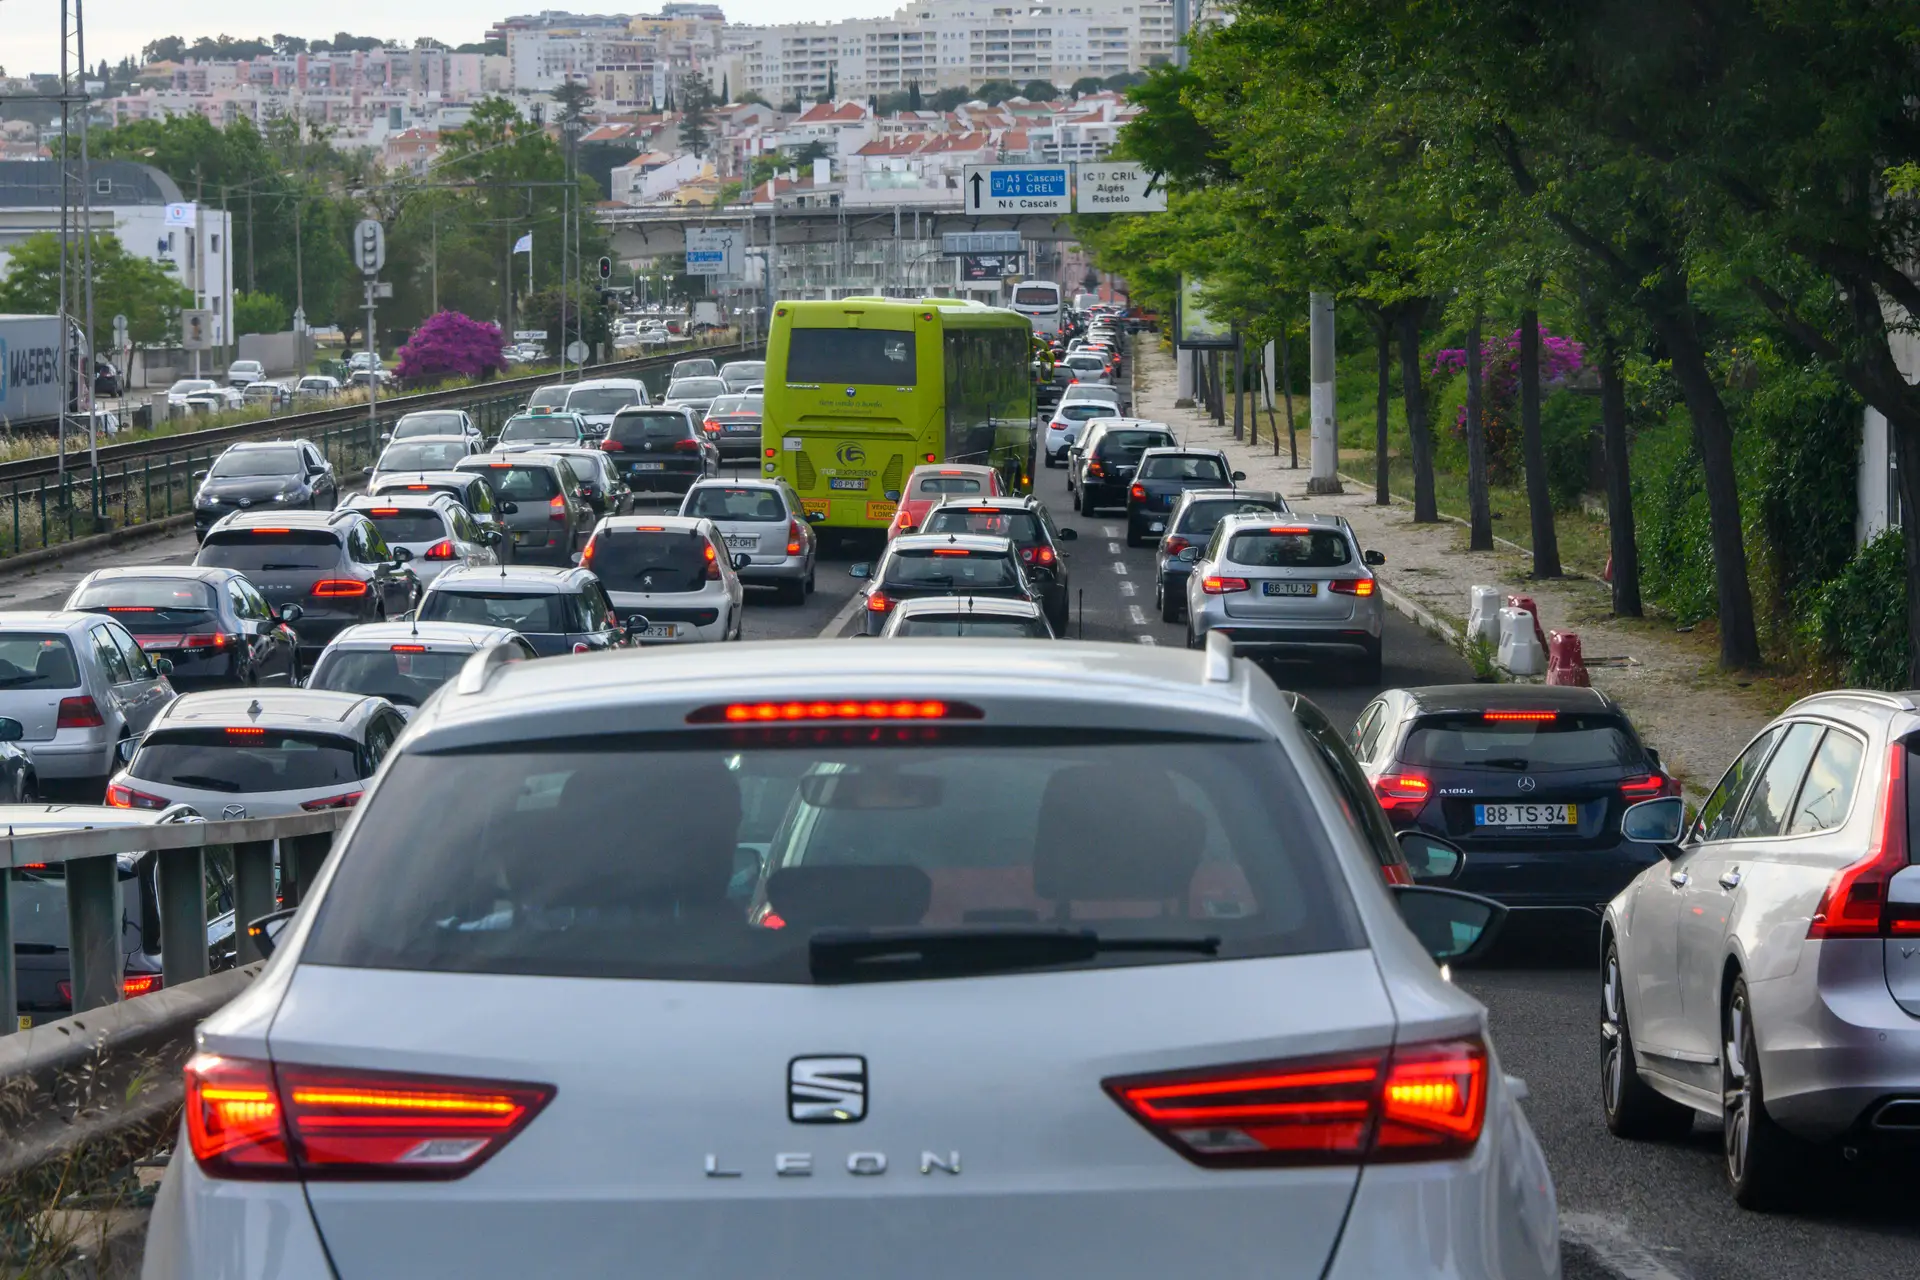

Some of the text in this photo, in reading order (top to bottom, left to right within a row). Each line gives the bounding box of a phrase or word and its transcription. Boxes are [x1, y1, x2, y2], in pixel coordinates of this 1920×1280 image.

[1026, 173, 1063, 182] Cascais
[1111, 171, 1137, 181] CRIL
[1026, 184, 1054, 193] CREL
[1096, 183, 1124, 193] Algés
[1092, 194, 1129, 203] Restelo
[1020, 199, 1057, 208] Cascais
[10, 346, 60, 388] MAERSK
[871, 503, 896, 511] VEICUL
[705, 1150, 961, 1178] LEON
